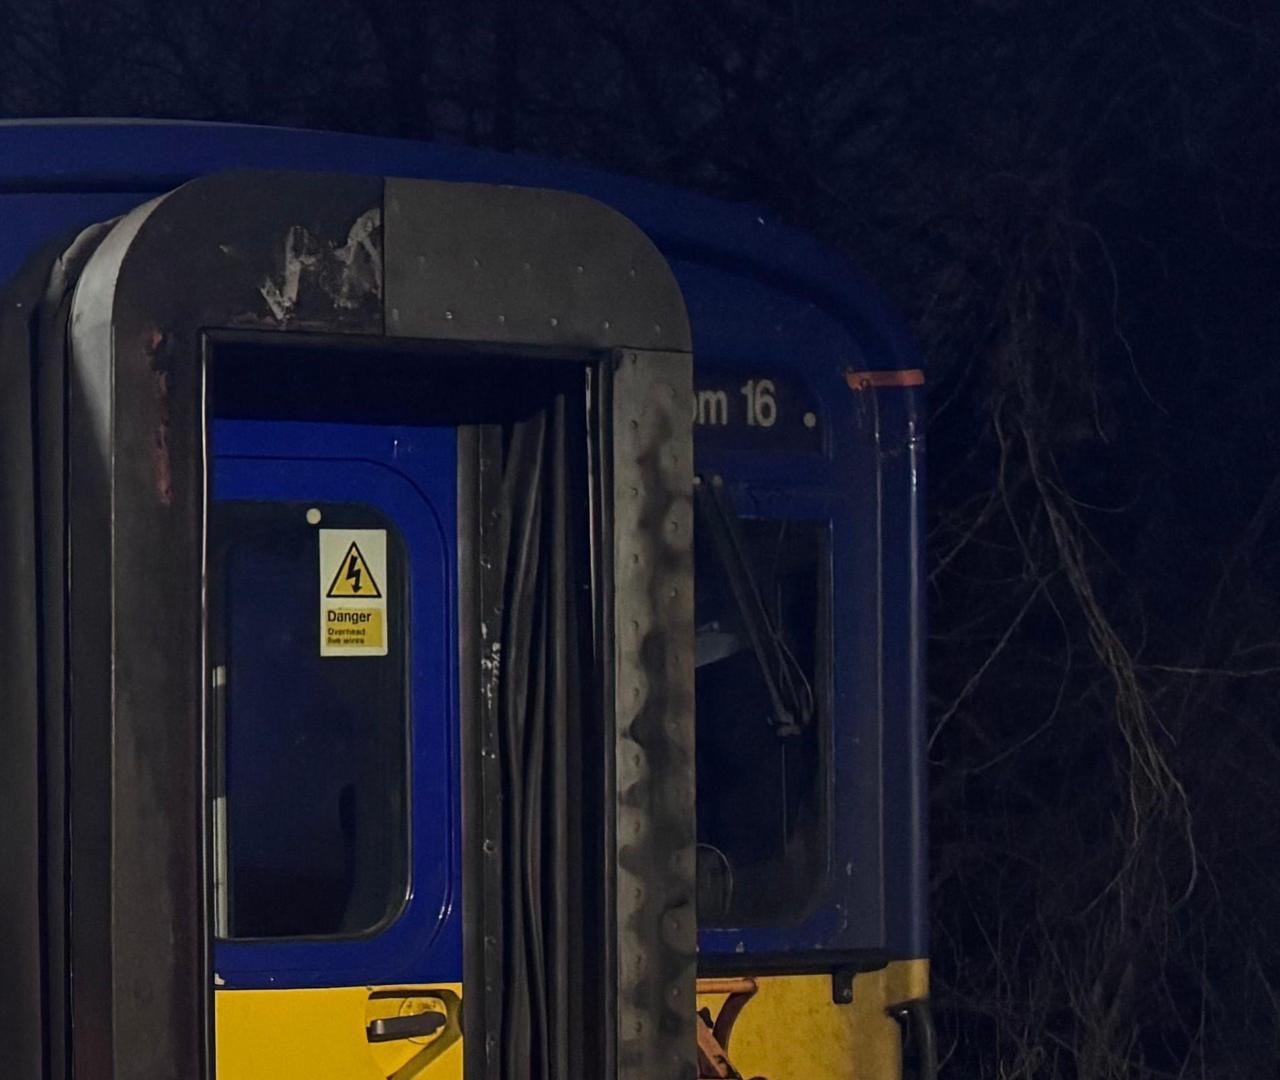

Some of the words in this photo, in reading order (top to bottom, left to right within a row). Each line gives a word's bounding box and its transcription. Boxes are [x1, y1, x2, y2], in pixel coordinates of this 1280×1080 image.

[741, 379, 777, 428] 16
[327, 610, 371, 625] Danger
[327, 627, 366, 636] Overhead
